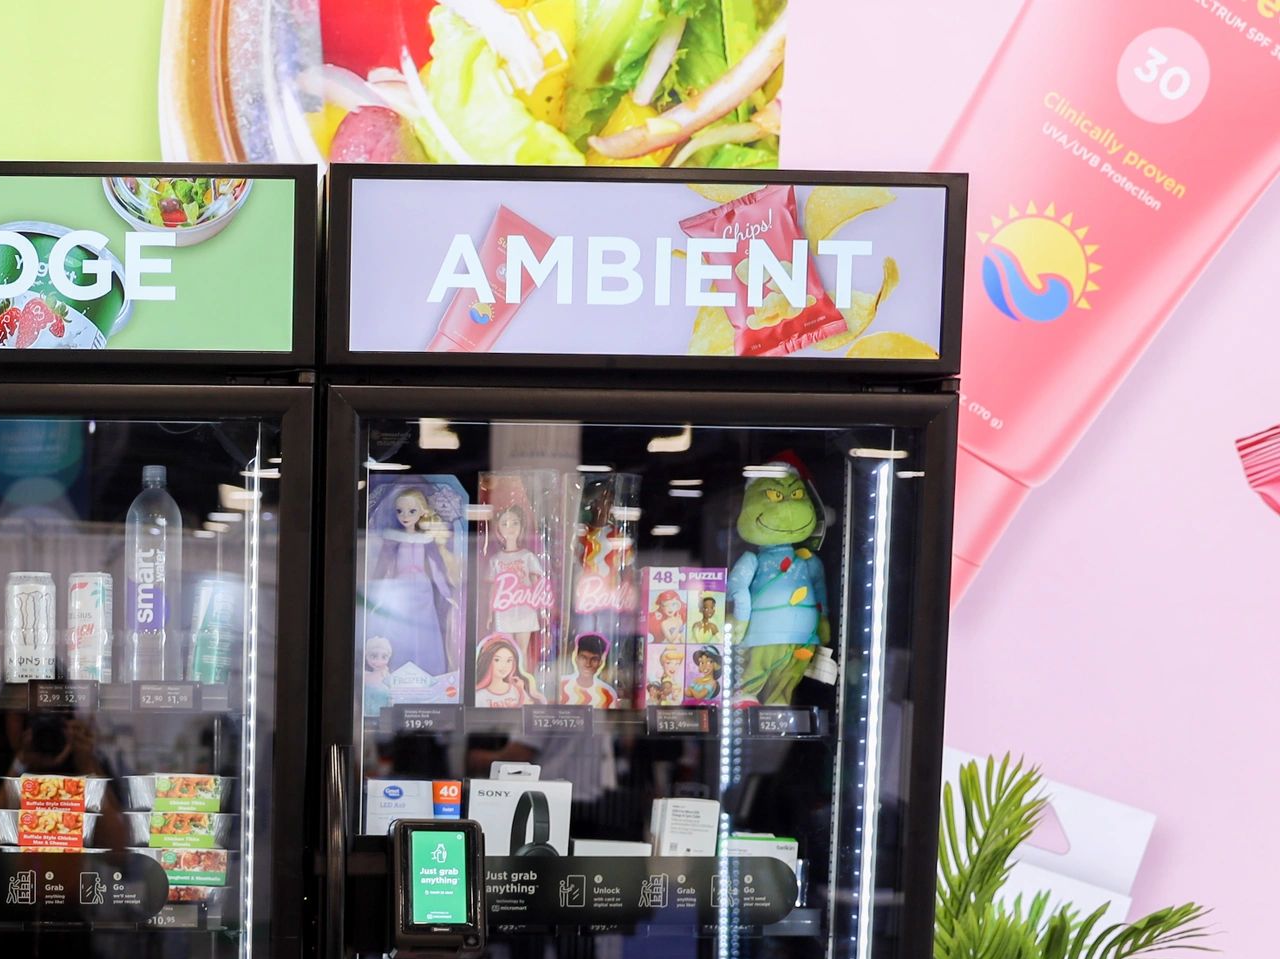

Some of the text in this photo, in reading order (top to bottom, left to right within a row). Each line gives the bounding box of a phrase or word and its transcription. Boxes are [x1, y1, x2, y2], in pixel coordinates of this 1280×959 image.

[1246, 27, 1272, 47] SPF
[1133, 46, 1191, 100] 30
[1043, 90, 1187, 199] Clinically proven
[1042, 121, 1162, 211] UVA/UVB Protection
[722, 208, 773, 242] Chips!
[427, 234, 872, 309] AMBIENT
[137, 548, 156, 624] smart
[653, 571, 673, 583] 48
[688, 571, 723, 581] PUZZLE
[493, 572, 555, 611] Barbie
[576, 576, 636, 613] Barbie
[405, 719, 433, 731] $19.99
[439, 785, 458, 796] 40
[478, 789, 511, 797] SONY
[439, 868, 459, 876] grab
[511, 871, 537, 883] grab
